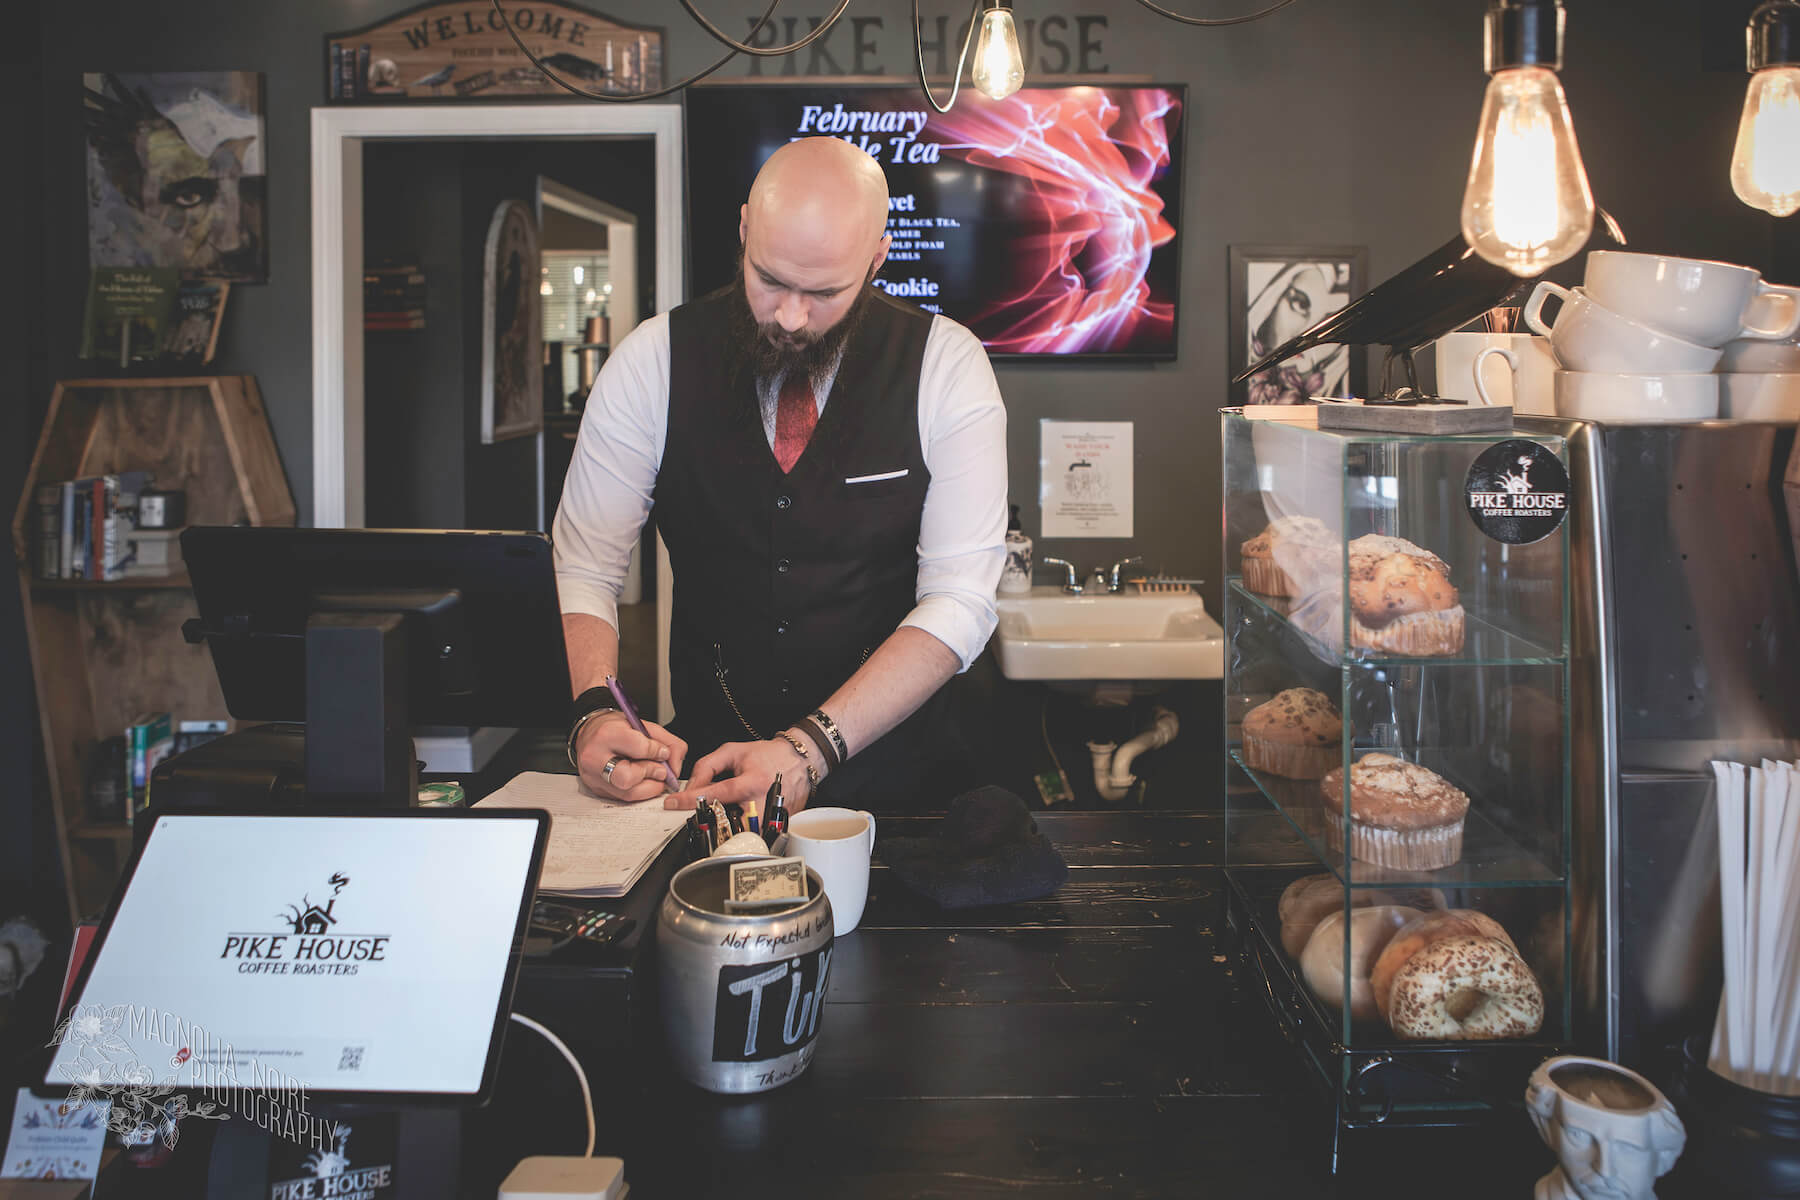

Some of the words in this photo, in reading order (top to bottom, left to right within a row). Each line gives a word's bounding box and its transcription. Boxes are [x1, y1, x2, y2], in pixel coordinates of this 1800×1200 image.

[403, 7, 591, 49] WELCOME
[746, 16, 885, 77] PIKE
[913, 15, 1110, 76] HSE
[797, 103, 929, 142] February
[889, 137, 941, 164] Tea
[886, 252, 921, 261] EARLS
[889, 241, 913, 250] OLD
[1470, 494, 1507, 509] PIKE
[1512, 494, 1566, 509] HOUSE
[1483, 508, 1513, 517] COFFEE
[1515, 508, 1553, 517] ROASTERS
[220, 936, 288, 960] PIKE
[294, 937, 391, 962] HOUSE
[720, 930, 752, 950] Not
[755, 921, 811, 955] Expected
[238, 961, 291, 975] COFFEE
[292, 963, 359, 976] ROASTERS
[272, 1179, 317, 1200] PIKE
[323, 1168, 391, 1197] HOUSE
